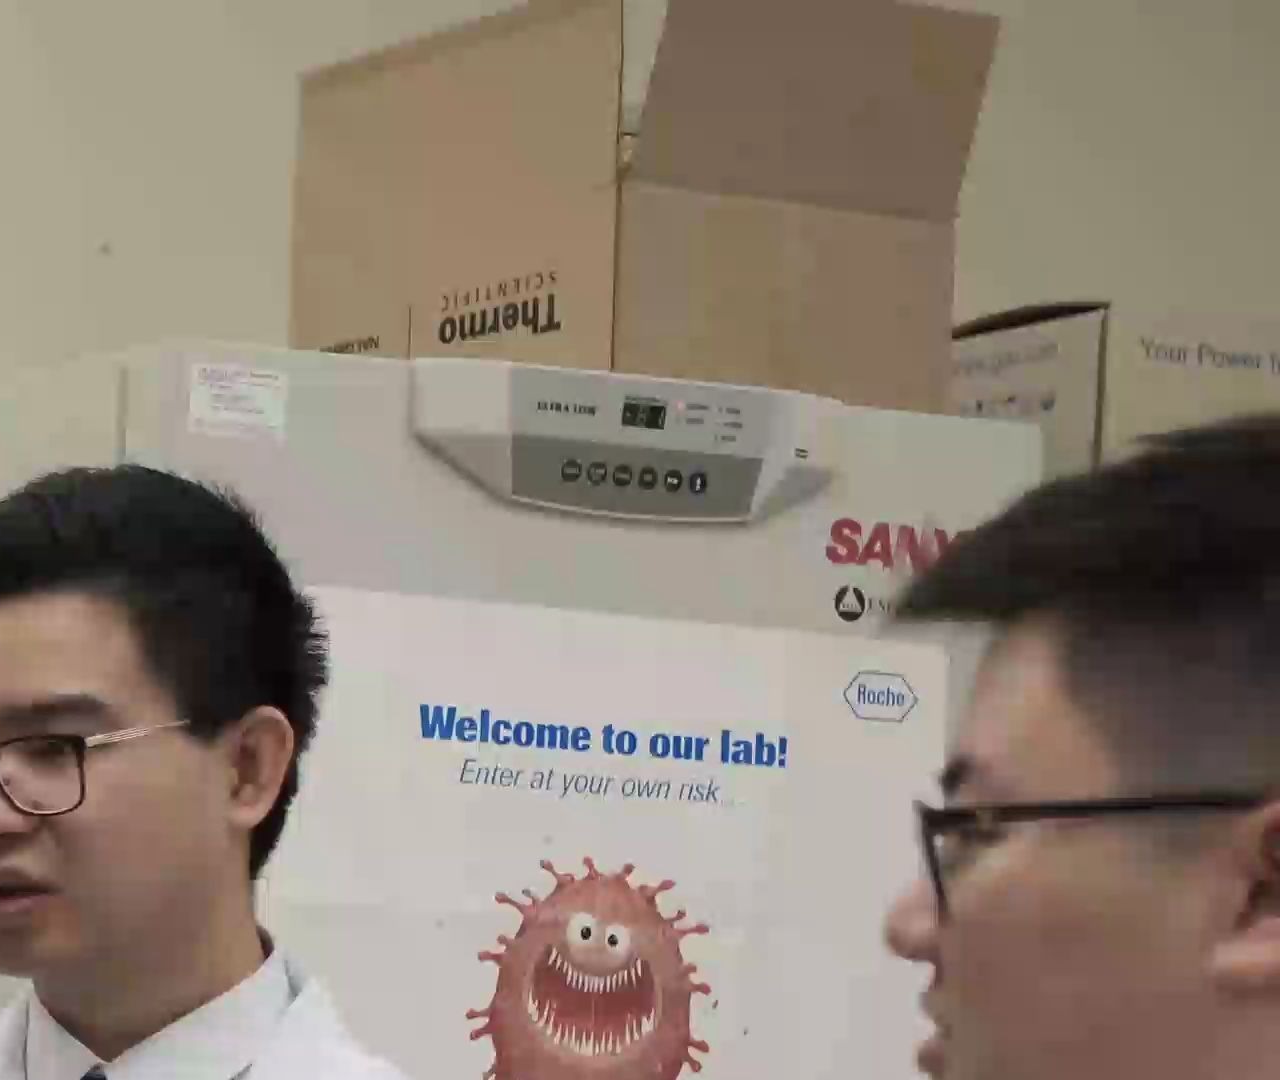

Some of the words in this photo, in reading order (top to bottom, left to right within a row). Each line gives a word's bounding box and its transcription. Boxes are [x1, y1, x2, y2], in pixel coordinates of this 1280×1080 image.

[441, 271, 558, 312] SCIENTIFIC
[439, 293, 561, 344] Thermo
[1140, 337, 1187, 364] Your
[857, 684, 905, 707] Roche
[419, 703, 591, 752] Welcome
[601, 724, 637, 756] to
[649, 732, 710, 761] our
[721, 730, 788, 768] lab!
[459, 759, 523, 787] Enter
[530, 766, 555, 791] at
[561, 775, 614, 799] your
[621, 779, 670, 800] own
